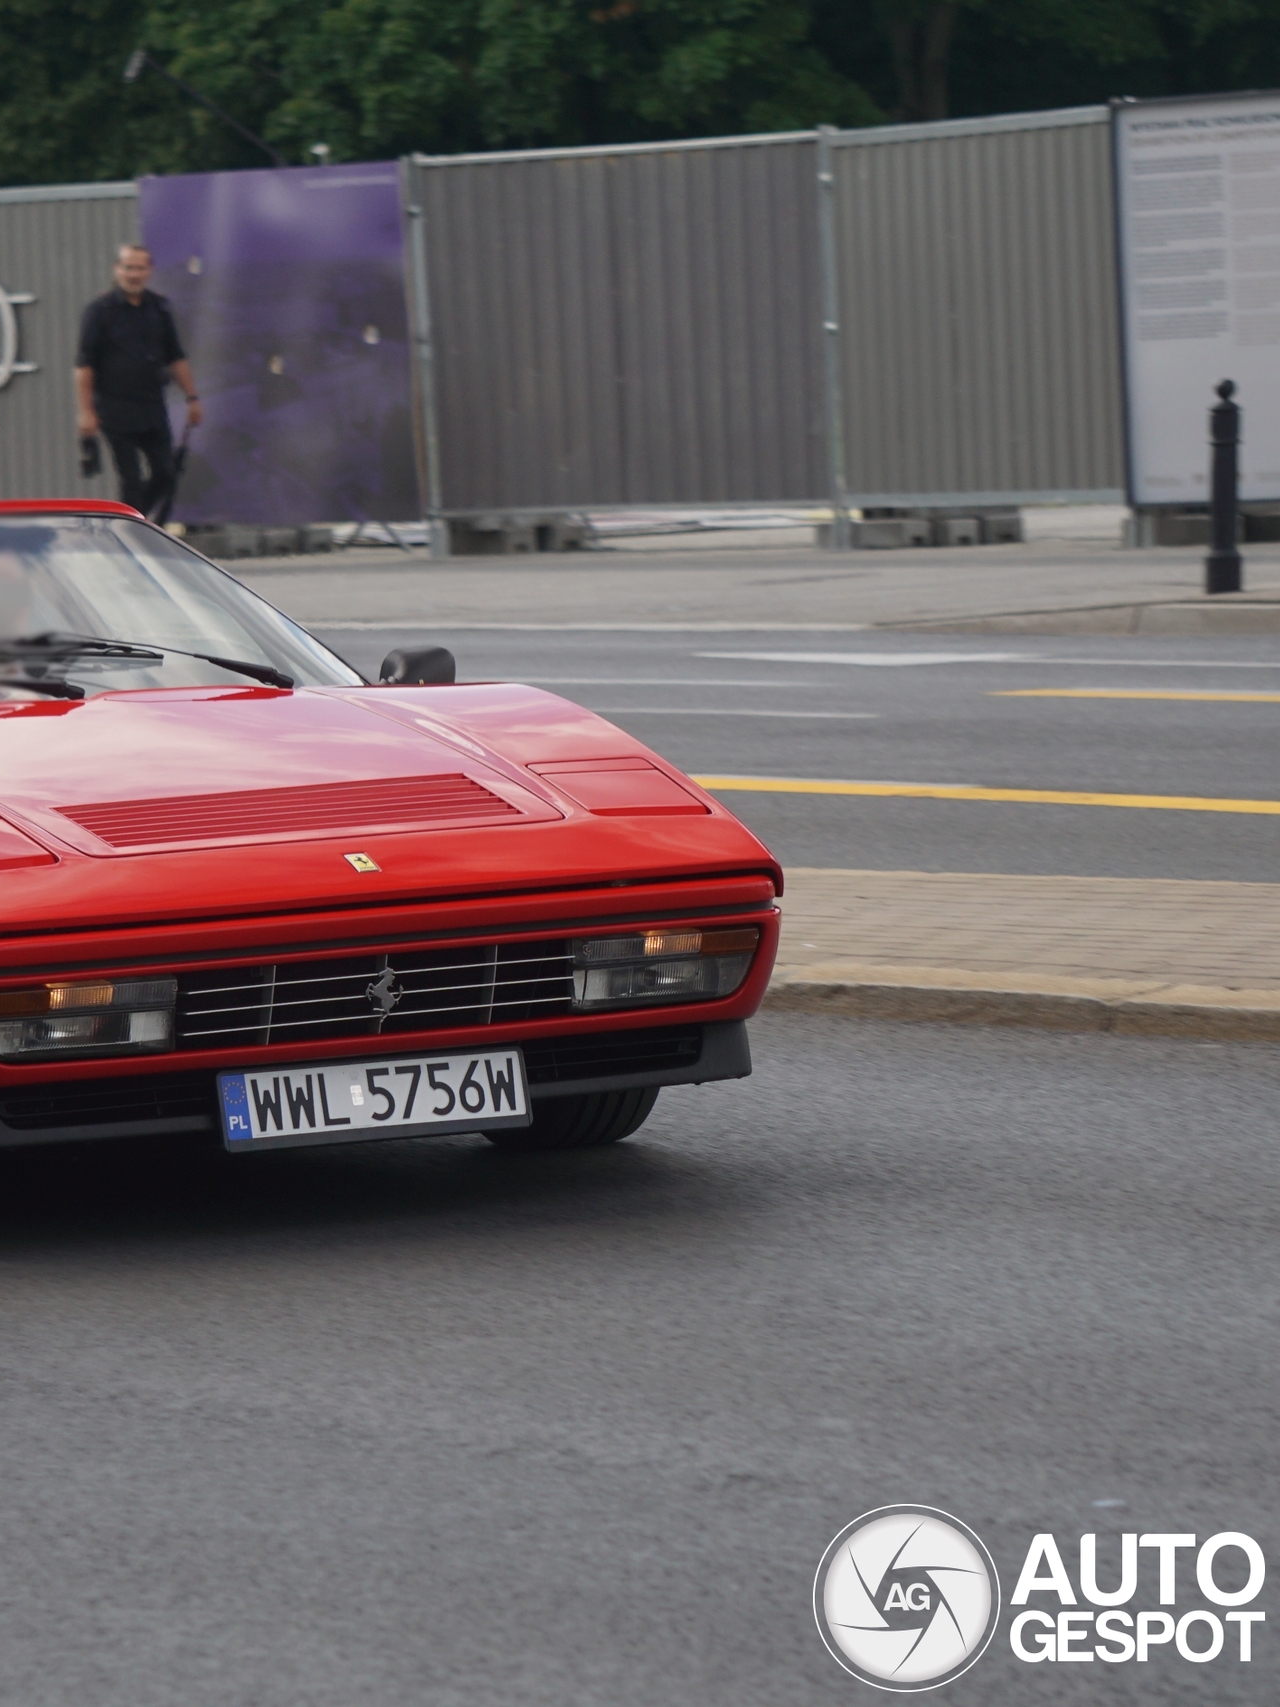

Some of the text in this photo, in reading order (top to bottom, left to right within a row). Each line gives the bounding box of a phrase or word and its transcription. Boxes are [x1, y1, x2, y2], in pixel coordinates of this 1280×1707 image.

[250, 1057, 517, 1132] WWL 5756W
[229, 1115, 248, 1131] PL
